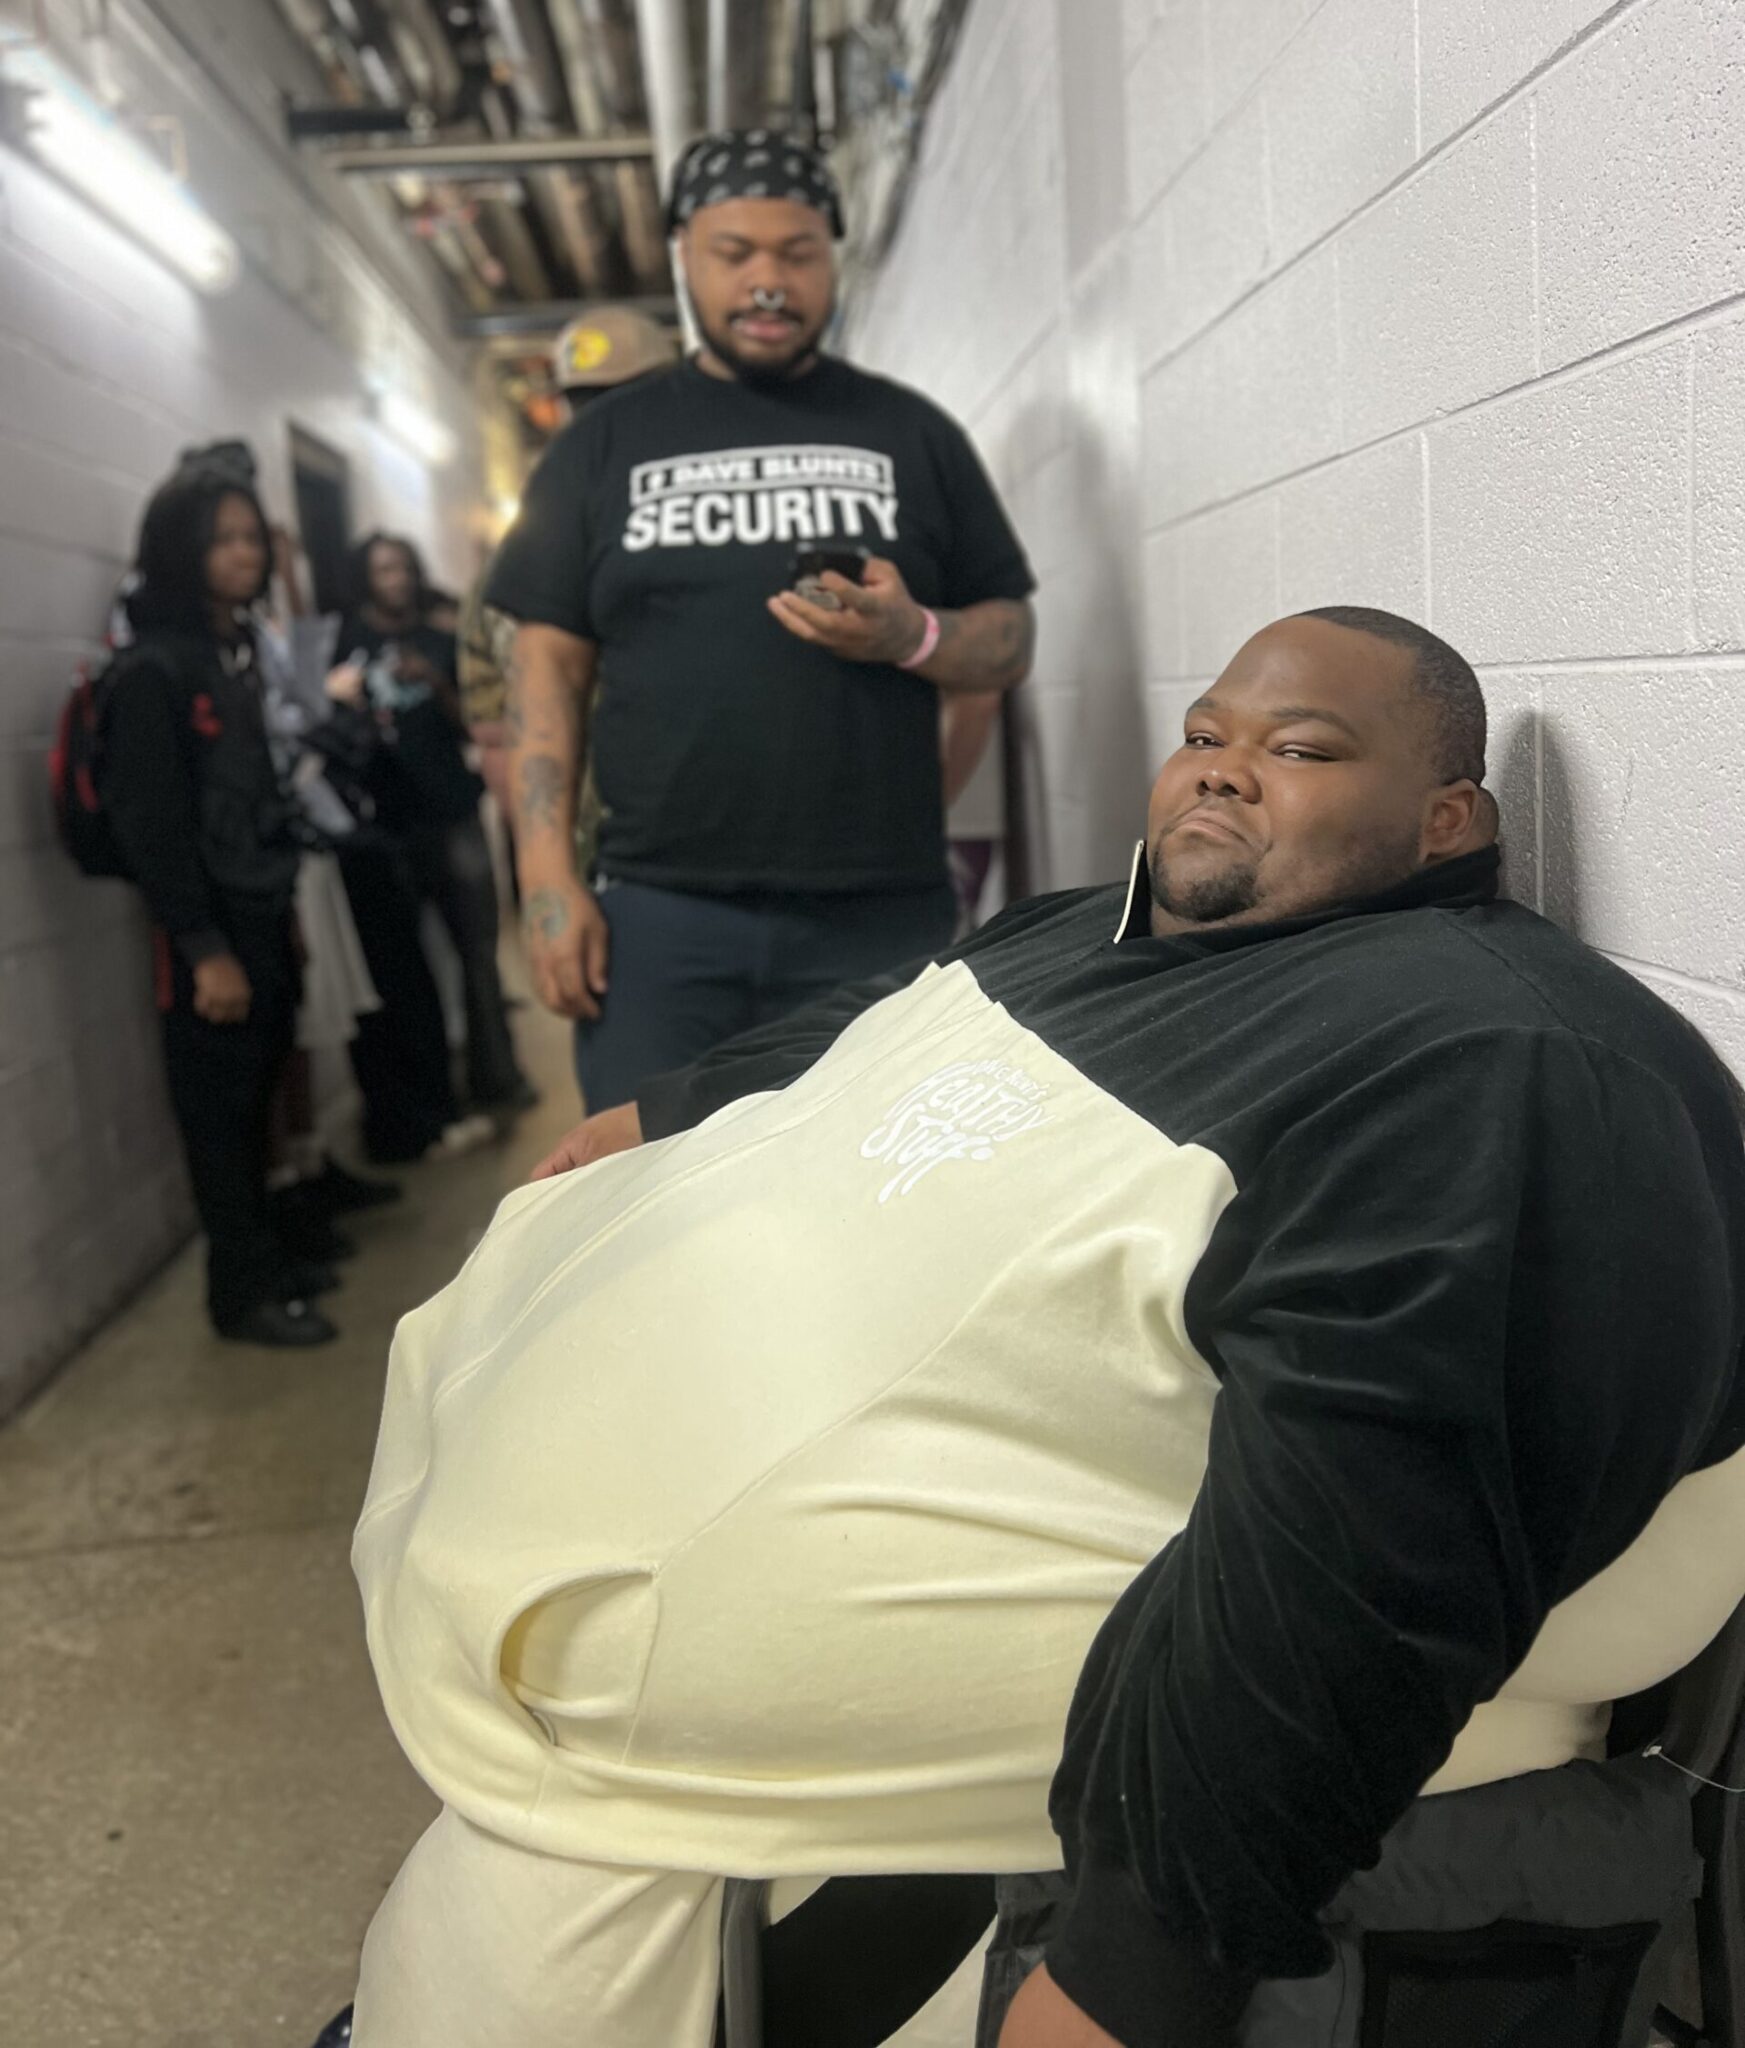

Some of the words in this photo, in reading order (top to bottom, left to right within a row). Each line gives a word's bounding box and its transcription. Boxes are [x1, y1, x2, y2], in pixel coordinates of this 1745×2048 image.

[673, 459, 754, 483] DAVE
[762, 456, 881, 480] BLUNTS
[622, 486, 898, 551] SECURITY
